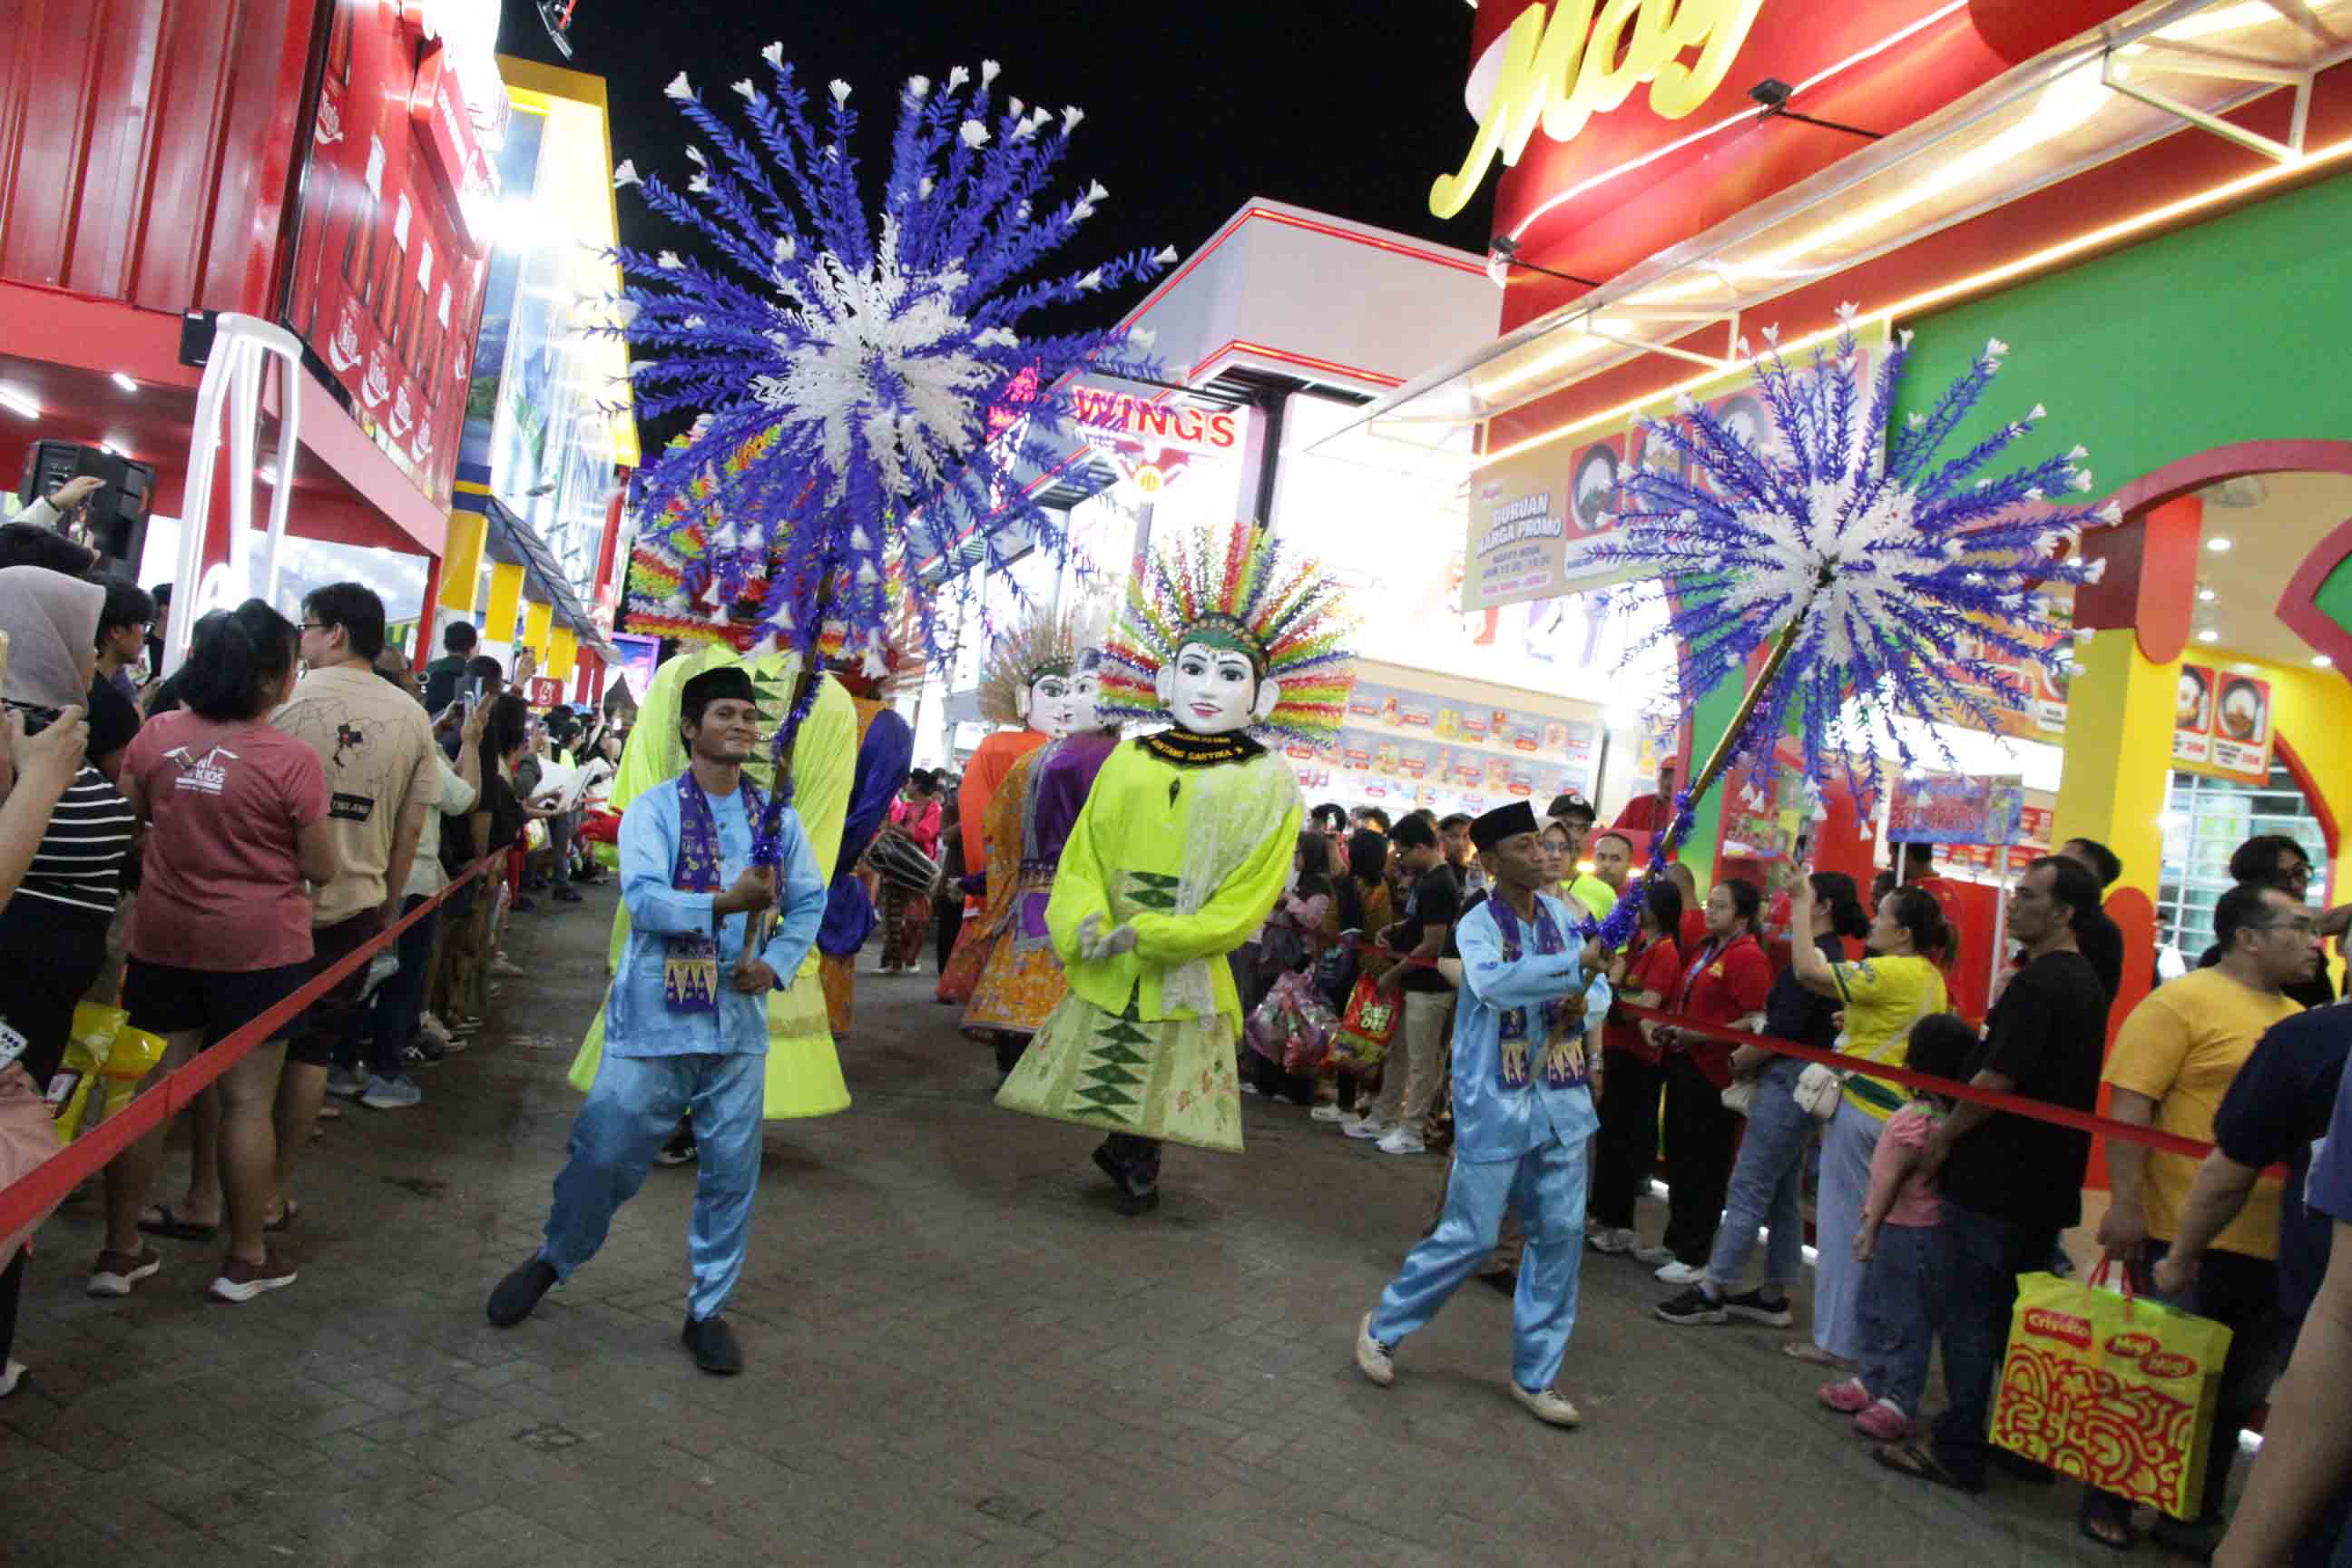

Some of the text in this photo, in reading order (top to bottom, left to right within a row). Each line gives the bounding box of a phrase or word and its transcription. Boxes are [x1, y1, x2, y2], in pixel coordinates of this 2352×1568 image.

[1073, 385, 1237, 448] WINGS
[1519, 516, 1562, 538] PROMO
[195, 769, 226, 784] KIDS
